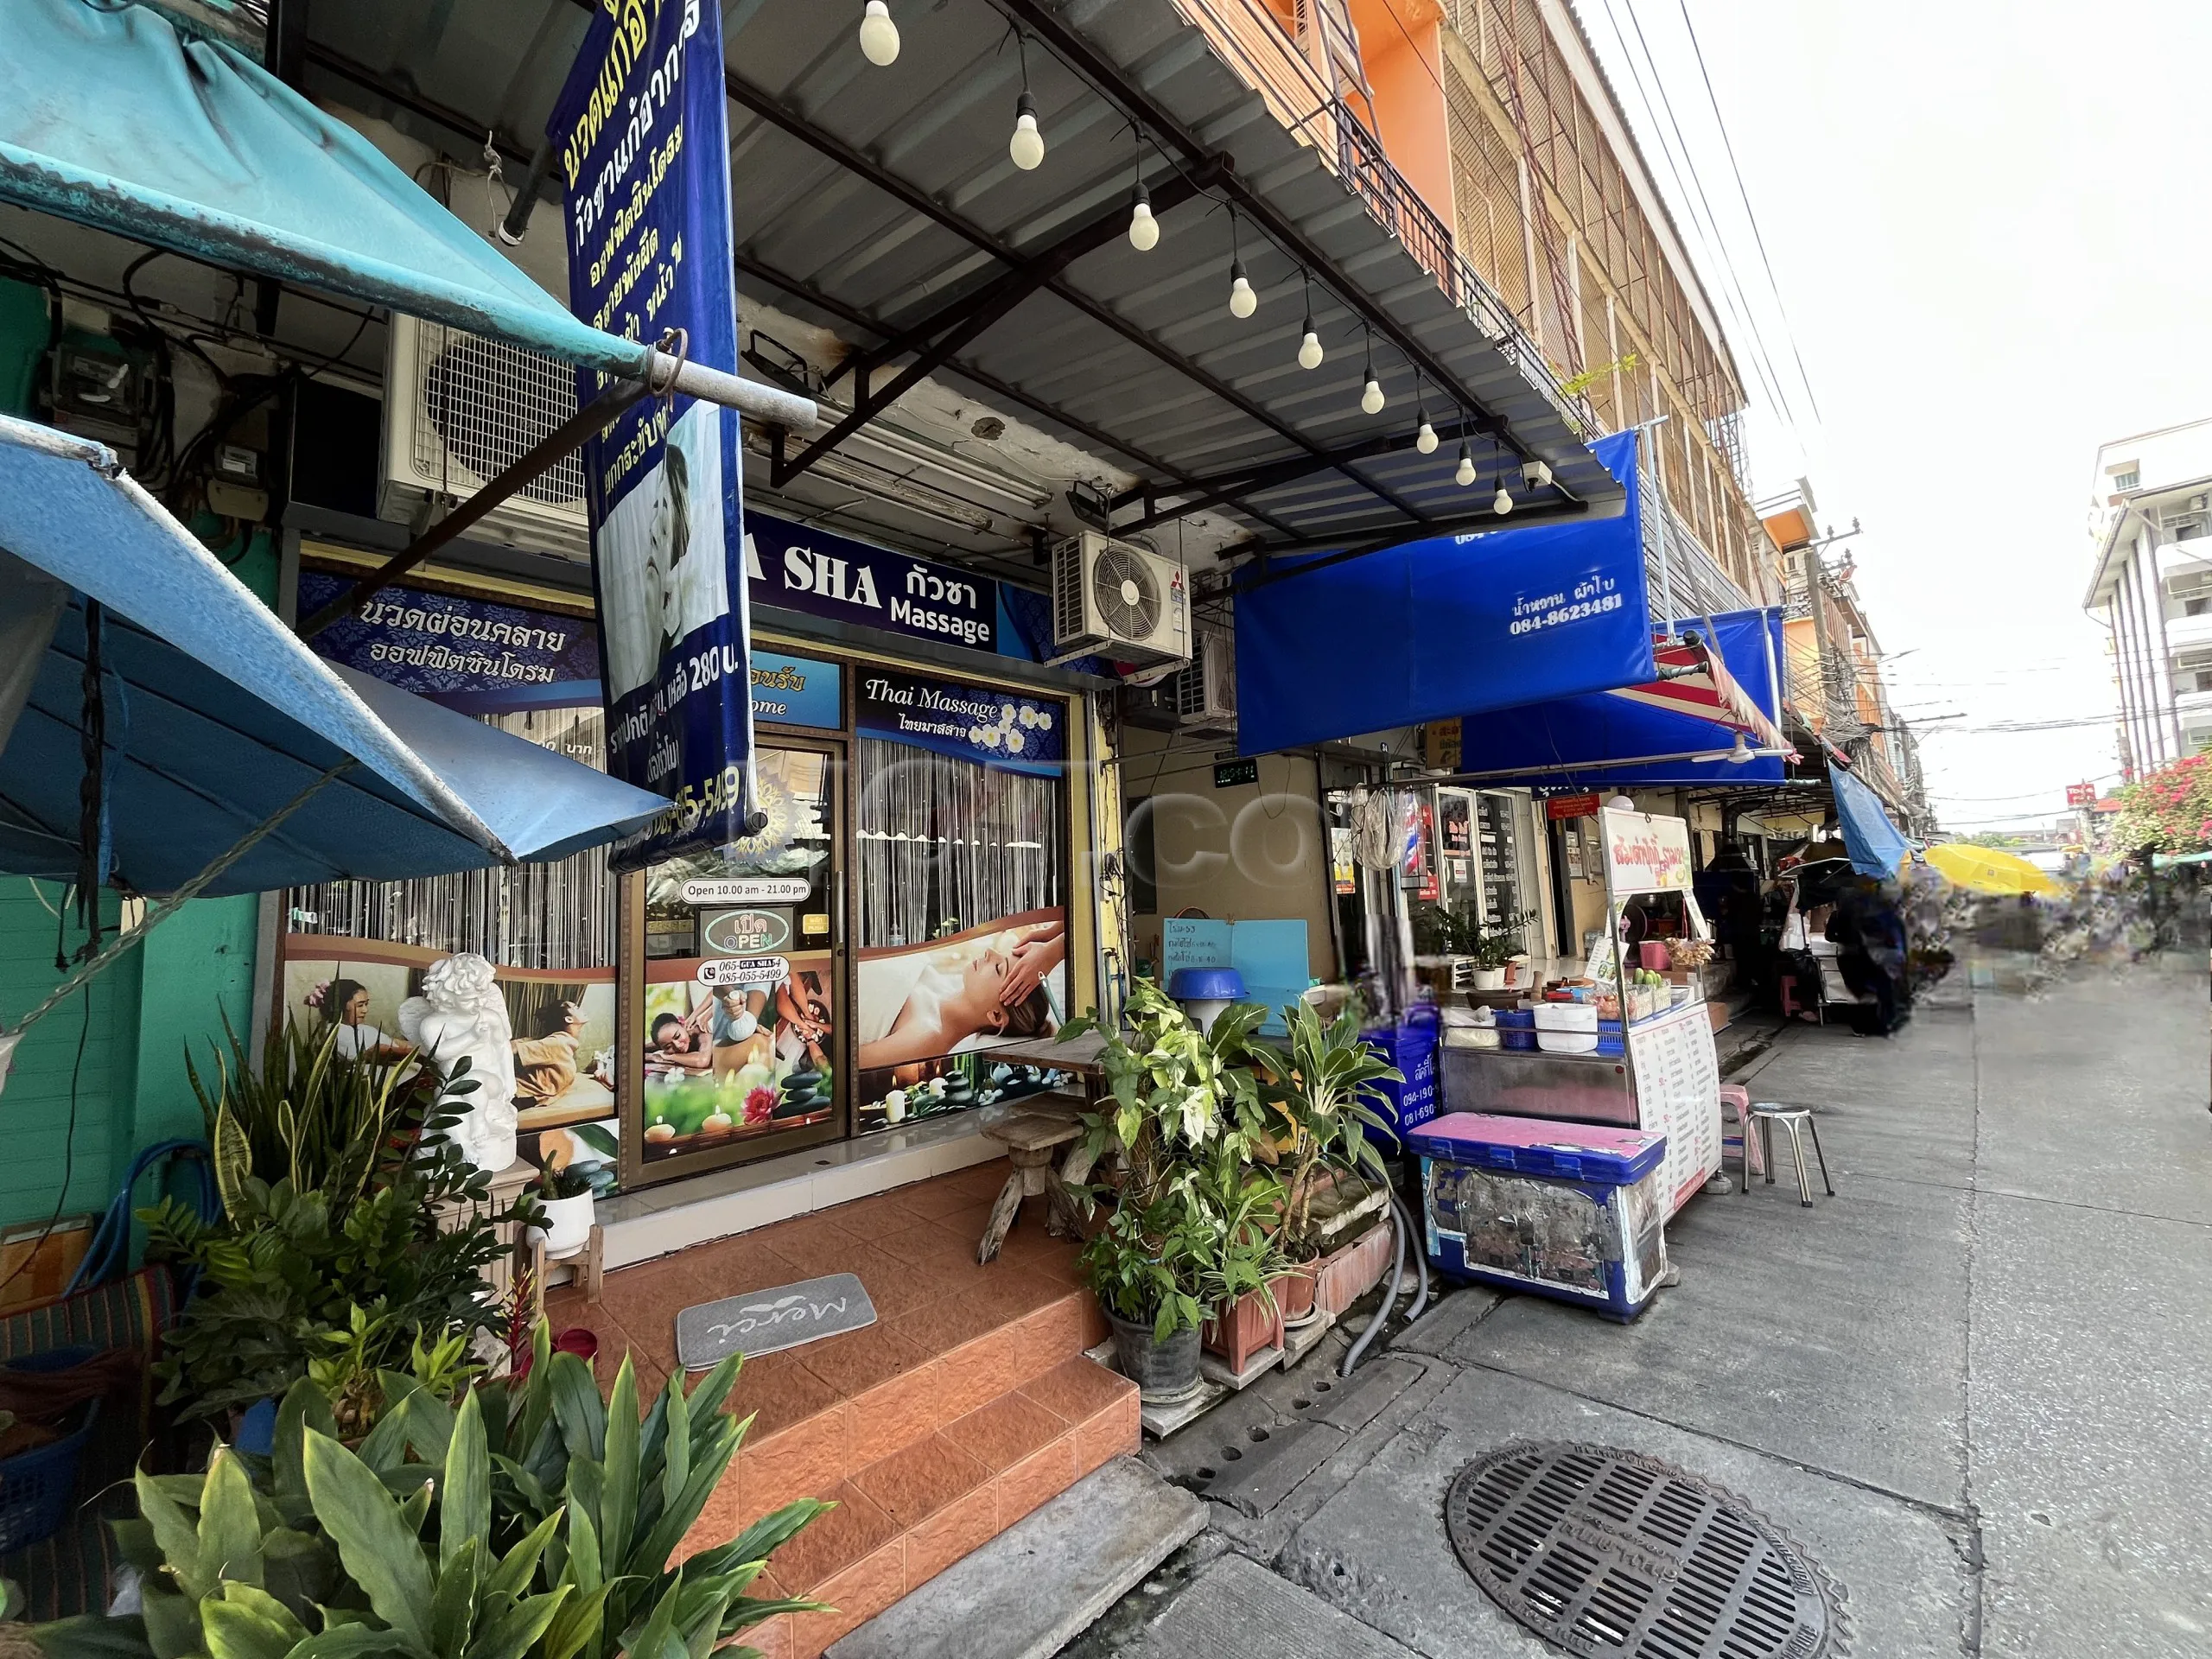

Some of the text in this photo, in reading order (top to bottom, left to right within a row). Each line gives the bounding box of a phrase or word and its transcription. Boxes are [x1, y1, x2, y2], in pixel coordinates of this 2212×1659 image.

[783, 546, 882, 608] SHA
[359, 601, 567, 652] นวดผ่อนคลาย
[890, 596, 990, 645] Massage
[1510, 593, 1623, 635] 084-8623481
[370, 643, 556, 683] ออฟฟิตซินโดรม
[690, 645, 721, 692] 280
[865, 678, 998, 723] Thai Massage
[688, 886, 715, 899] Open
[717, 885, 743, 895] 10.00
[745, 887, 760, 895] am
[767, 884, 791, 894] 21.00
[793, 886, 807, 896] pm
[723, 933, 773, 950] OPEN
[734, 913, 767, 934] เปิด
[719, 969, 782, 983] 085-055-5499
[707, 1296, 848, 1344] Merci
